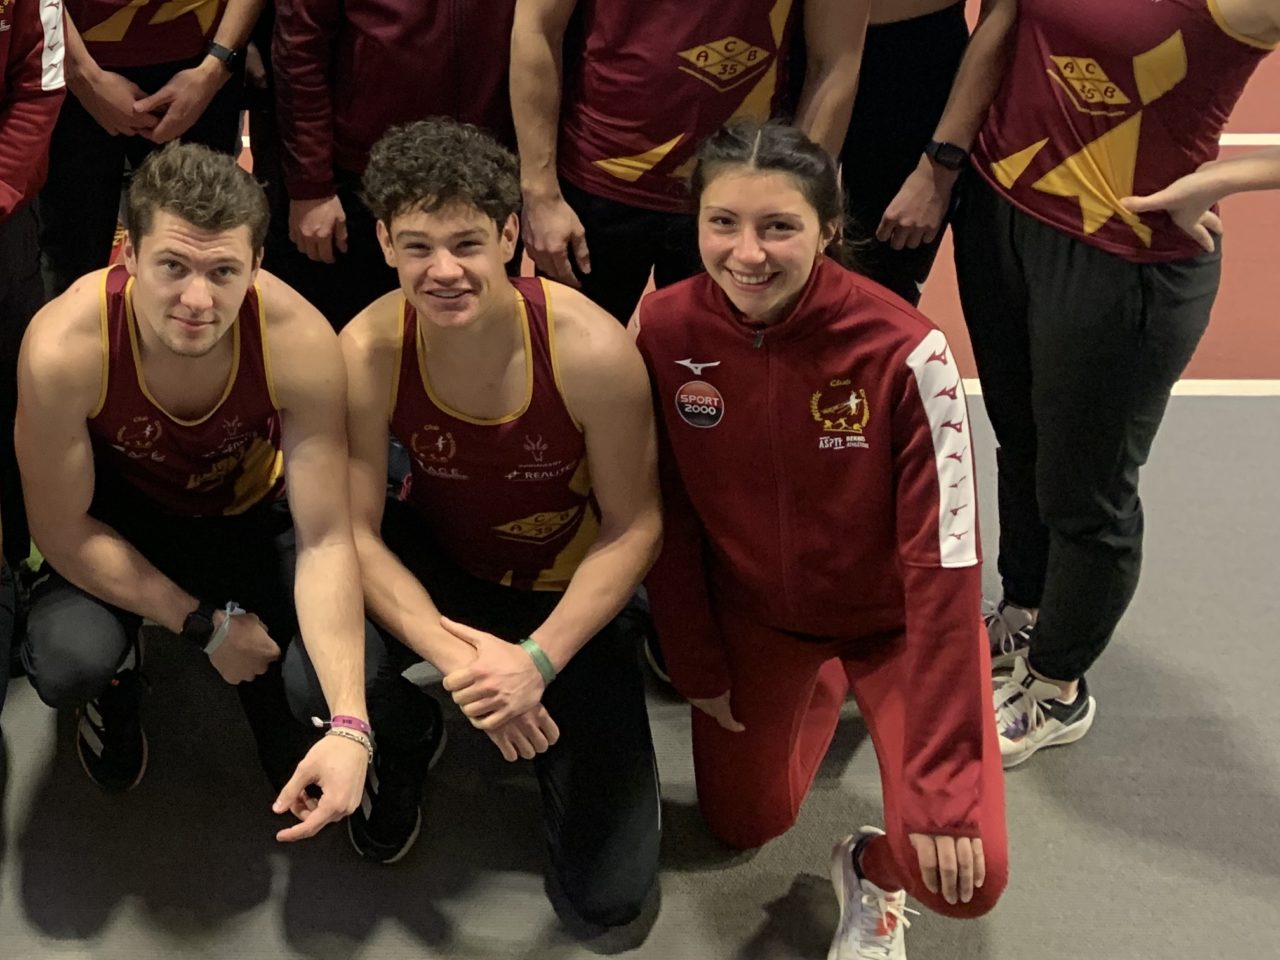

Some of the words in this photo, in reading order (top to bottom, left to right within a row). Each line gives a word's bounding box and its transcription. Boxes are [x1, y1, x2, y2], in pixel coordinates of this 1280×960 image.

[718, 63, 738, 75] 35
[680, 394, 720, 407] SPORT
[684, 403, 717, 416] 2000
